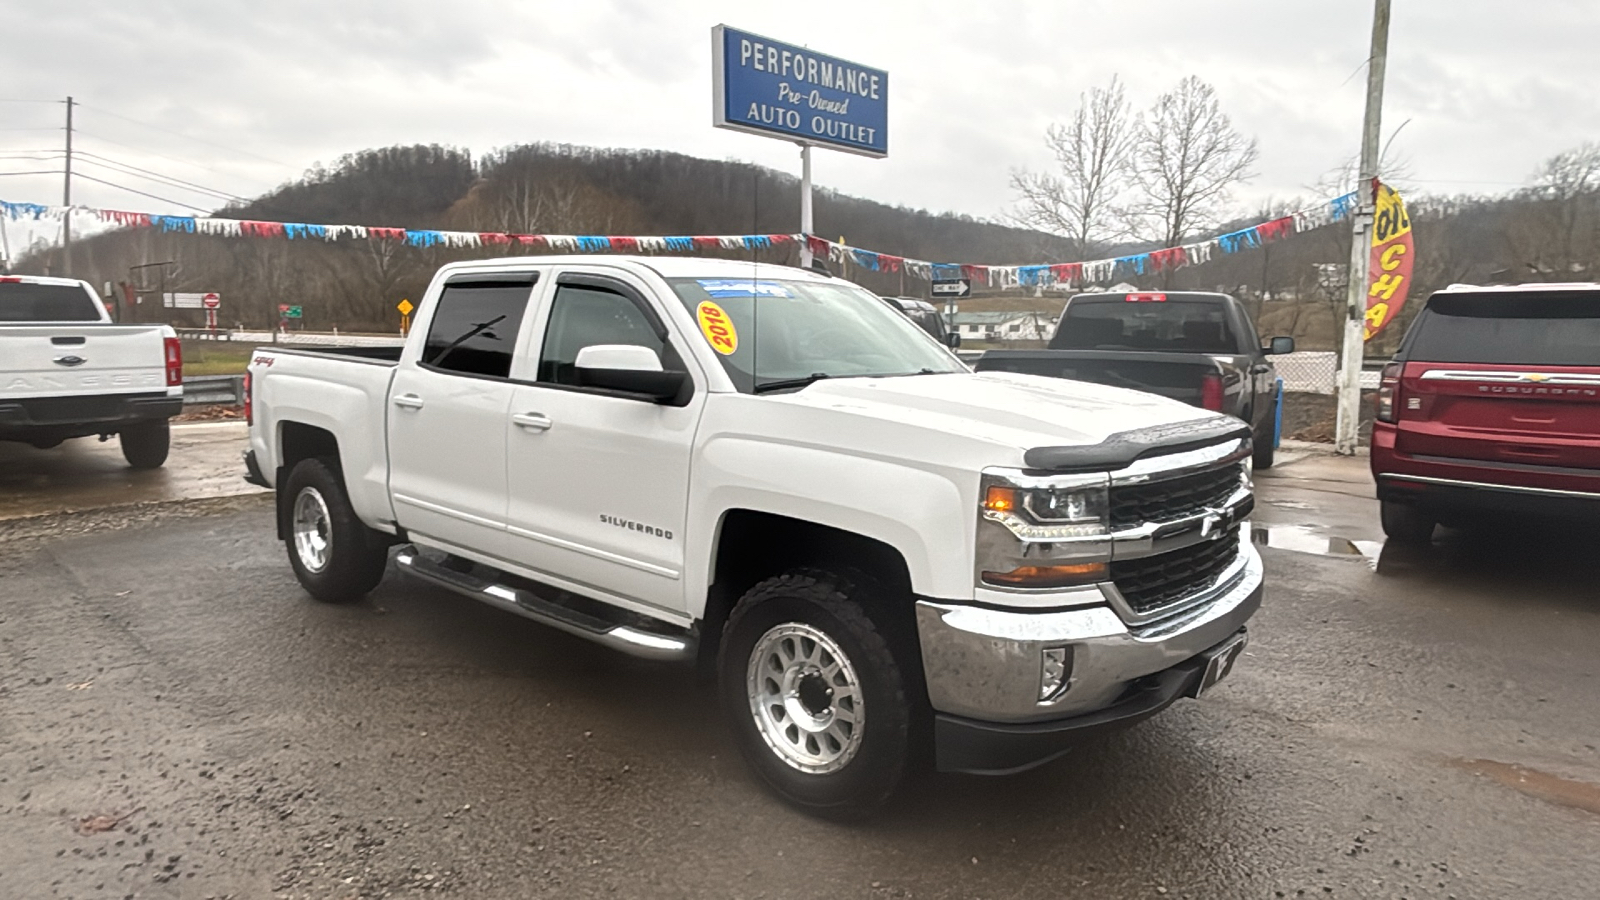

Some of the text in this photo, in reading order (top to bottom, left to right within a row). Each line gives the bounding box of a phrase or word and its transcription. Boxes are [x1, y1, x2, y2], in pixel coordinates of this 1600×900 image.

[741, 39, 879, 100] PERFORMANCE
[778, 82, 849, 115] Pre-Owned
[747, 102, 876, 145] AUTO OUTLET
[701, 306, 733, 349] 2018
[1478, 385, 1596, 396] SUBURBAN
[599, 514, 673, 540] SILVERADO
